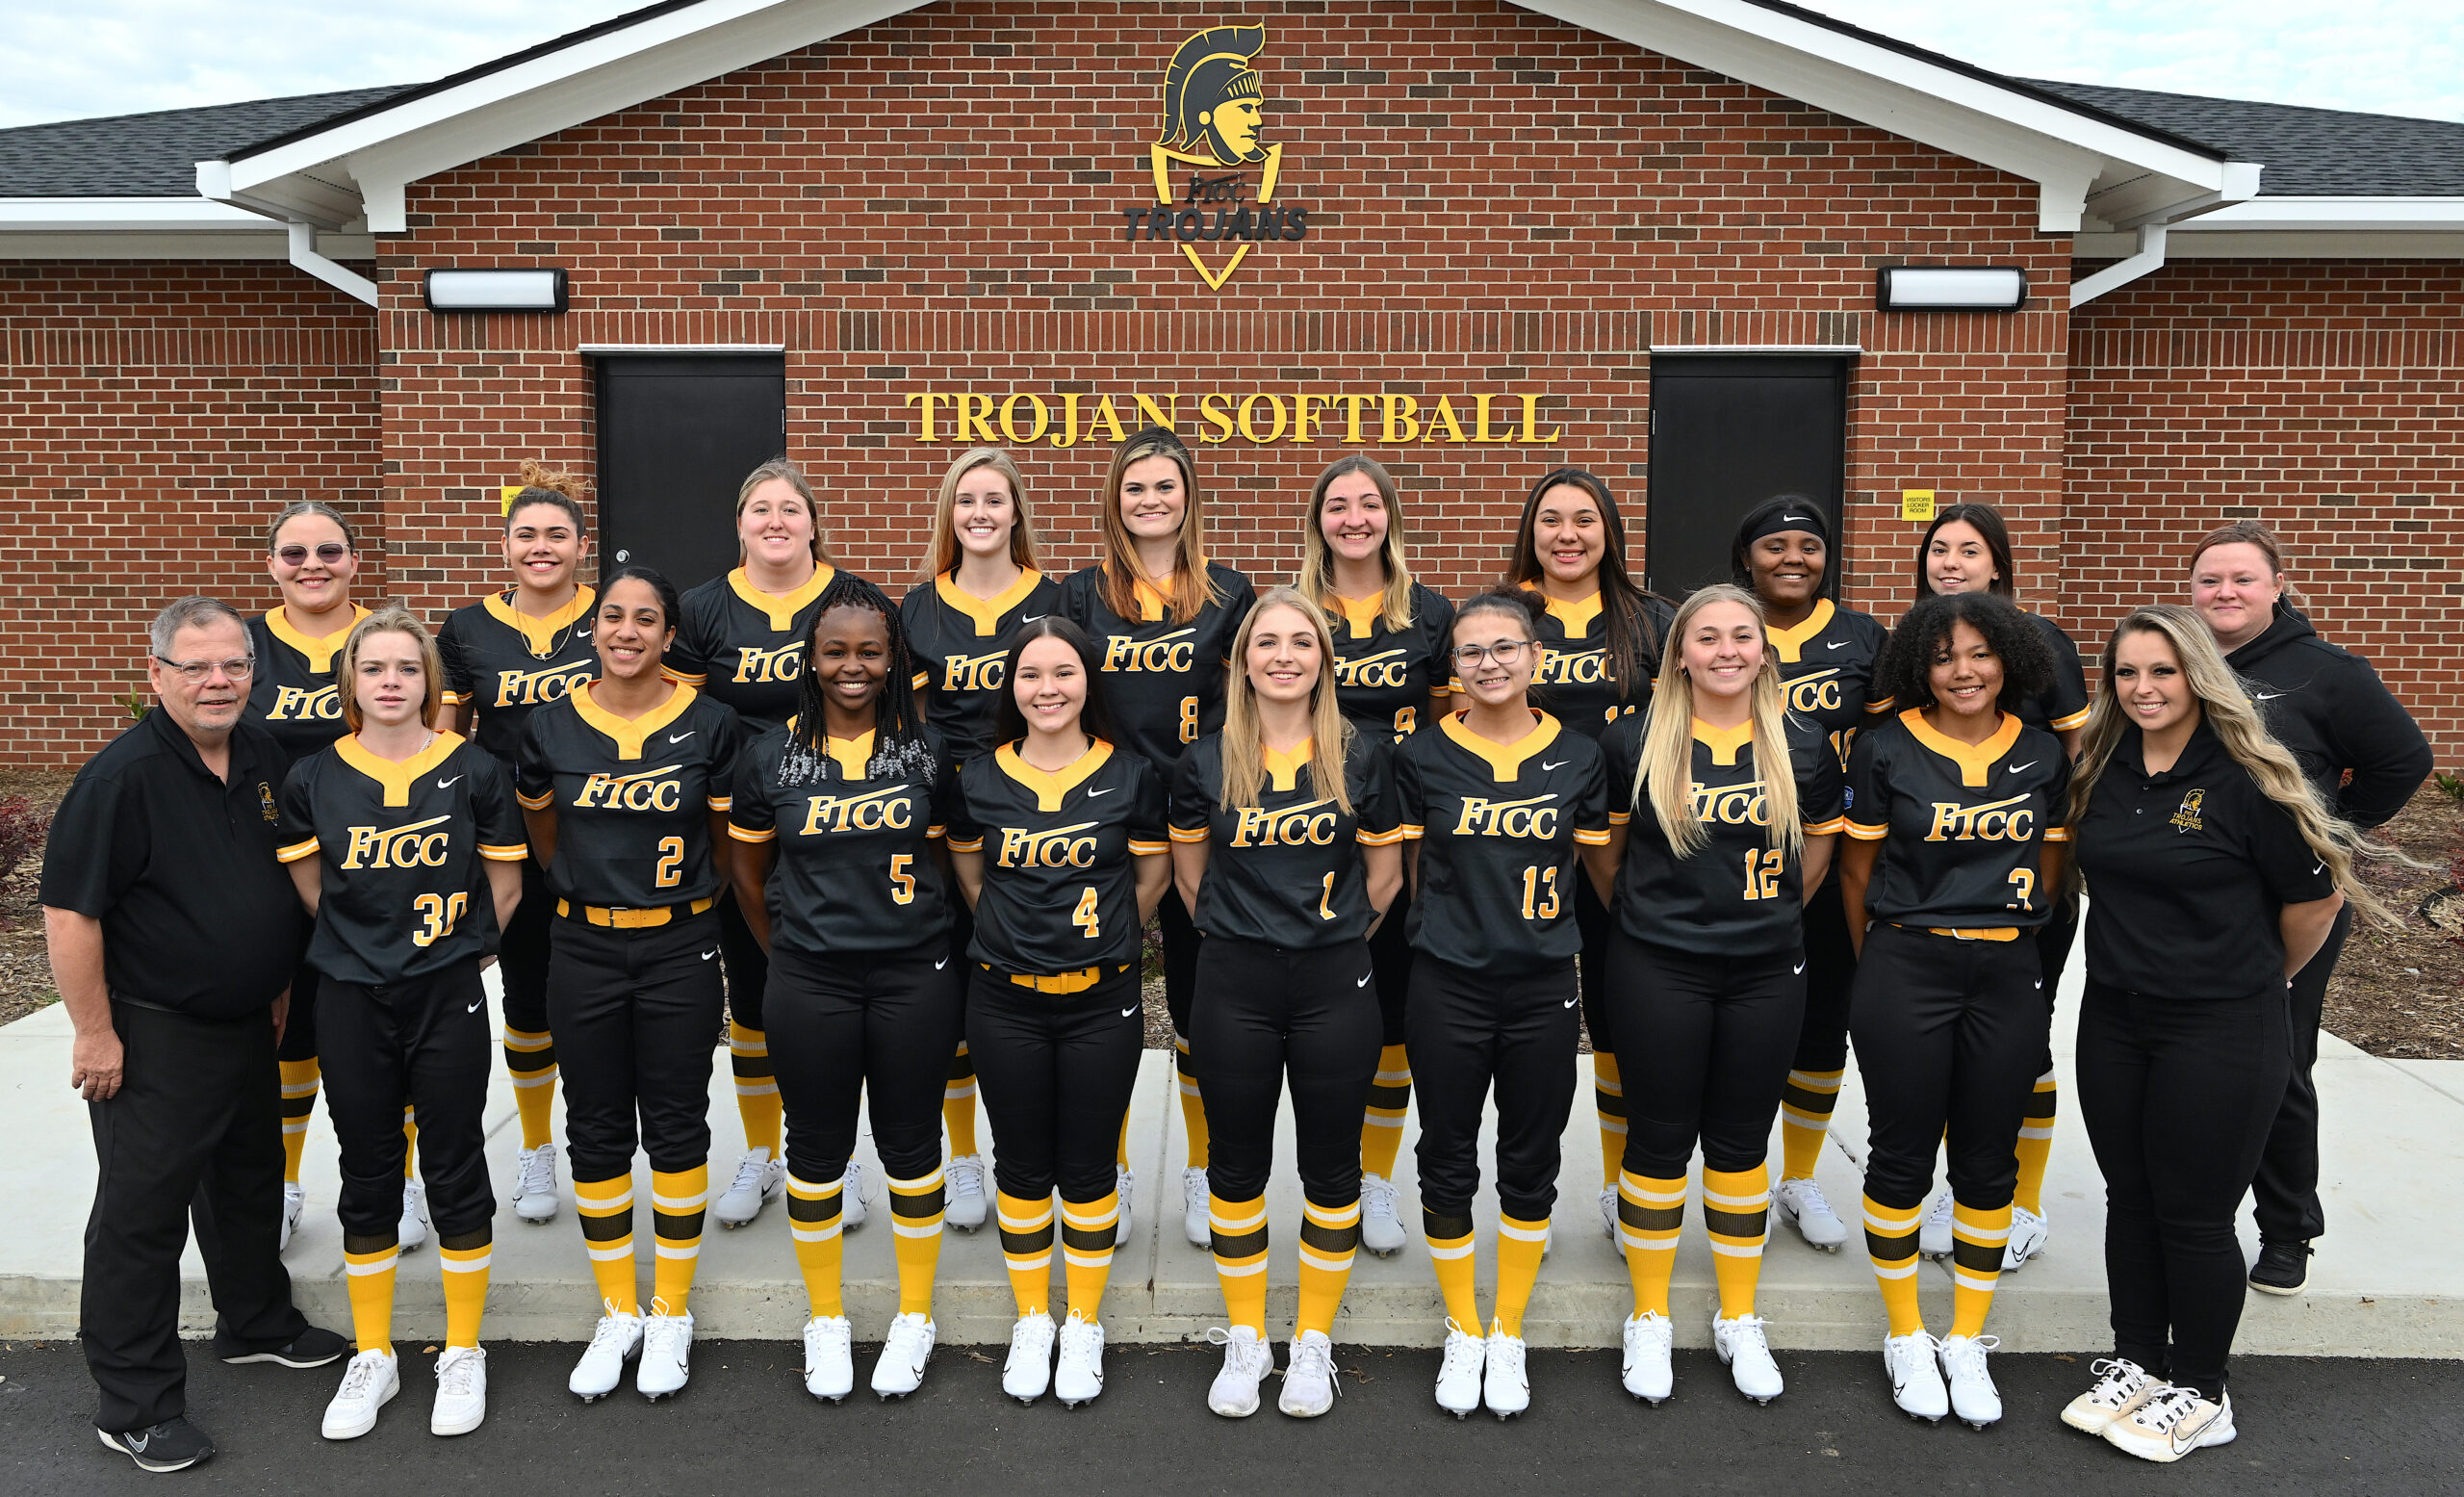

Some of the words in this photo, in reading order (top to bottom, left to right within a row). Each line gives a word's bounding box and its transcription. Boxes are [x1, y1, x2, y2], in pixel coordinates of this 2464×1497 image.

[1123, 207, 1308, 241] TROJANS
[907, 393, 1180, 448] TROJAN
[1199, 393, 1561, 444] SOFTBALL
[732, 640, 806, 683] FTC
[941, 649, 1011, 690] FTC
[1100, 628, 1197, 672] FTCC
[266, 684, 344, 720] FTC
[1778, 667, 1841, 712] TCC
[1179, 695, 1199, 744] 8
[1394, 706, 1417, 745] 9
[573, 763, 683, 813] FTCC
[799, 784, 912, 836] FTCC
[1230, 797, 1337, 848] FTCC
[1451, 793, 1558, 840] FTCC
[1923, 792, 2034, 841] FTCC
[340, 814, 451, 870] FTCC
[654, 836, 684, 888] 2
[996, 821, 1099, 868] FTCC
[889, 853, 916, 906] 5
[1320, 870, 1338, 921] 1
[1521, 865, 1560, 920] 13
[1743, 848, 1784, 900] 12
[2006, 867, 2035, 911] 3
[412, 890, 468, 947] 30
[1071, 887, 1100, 939] 4
